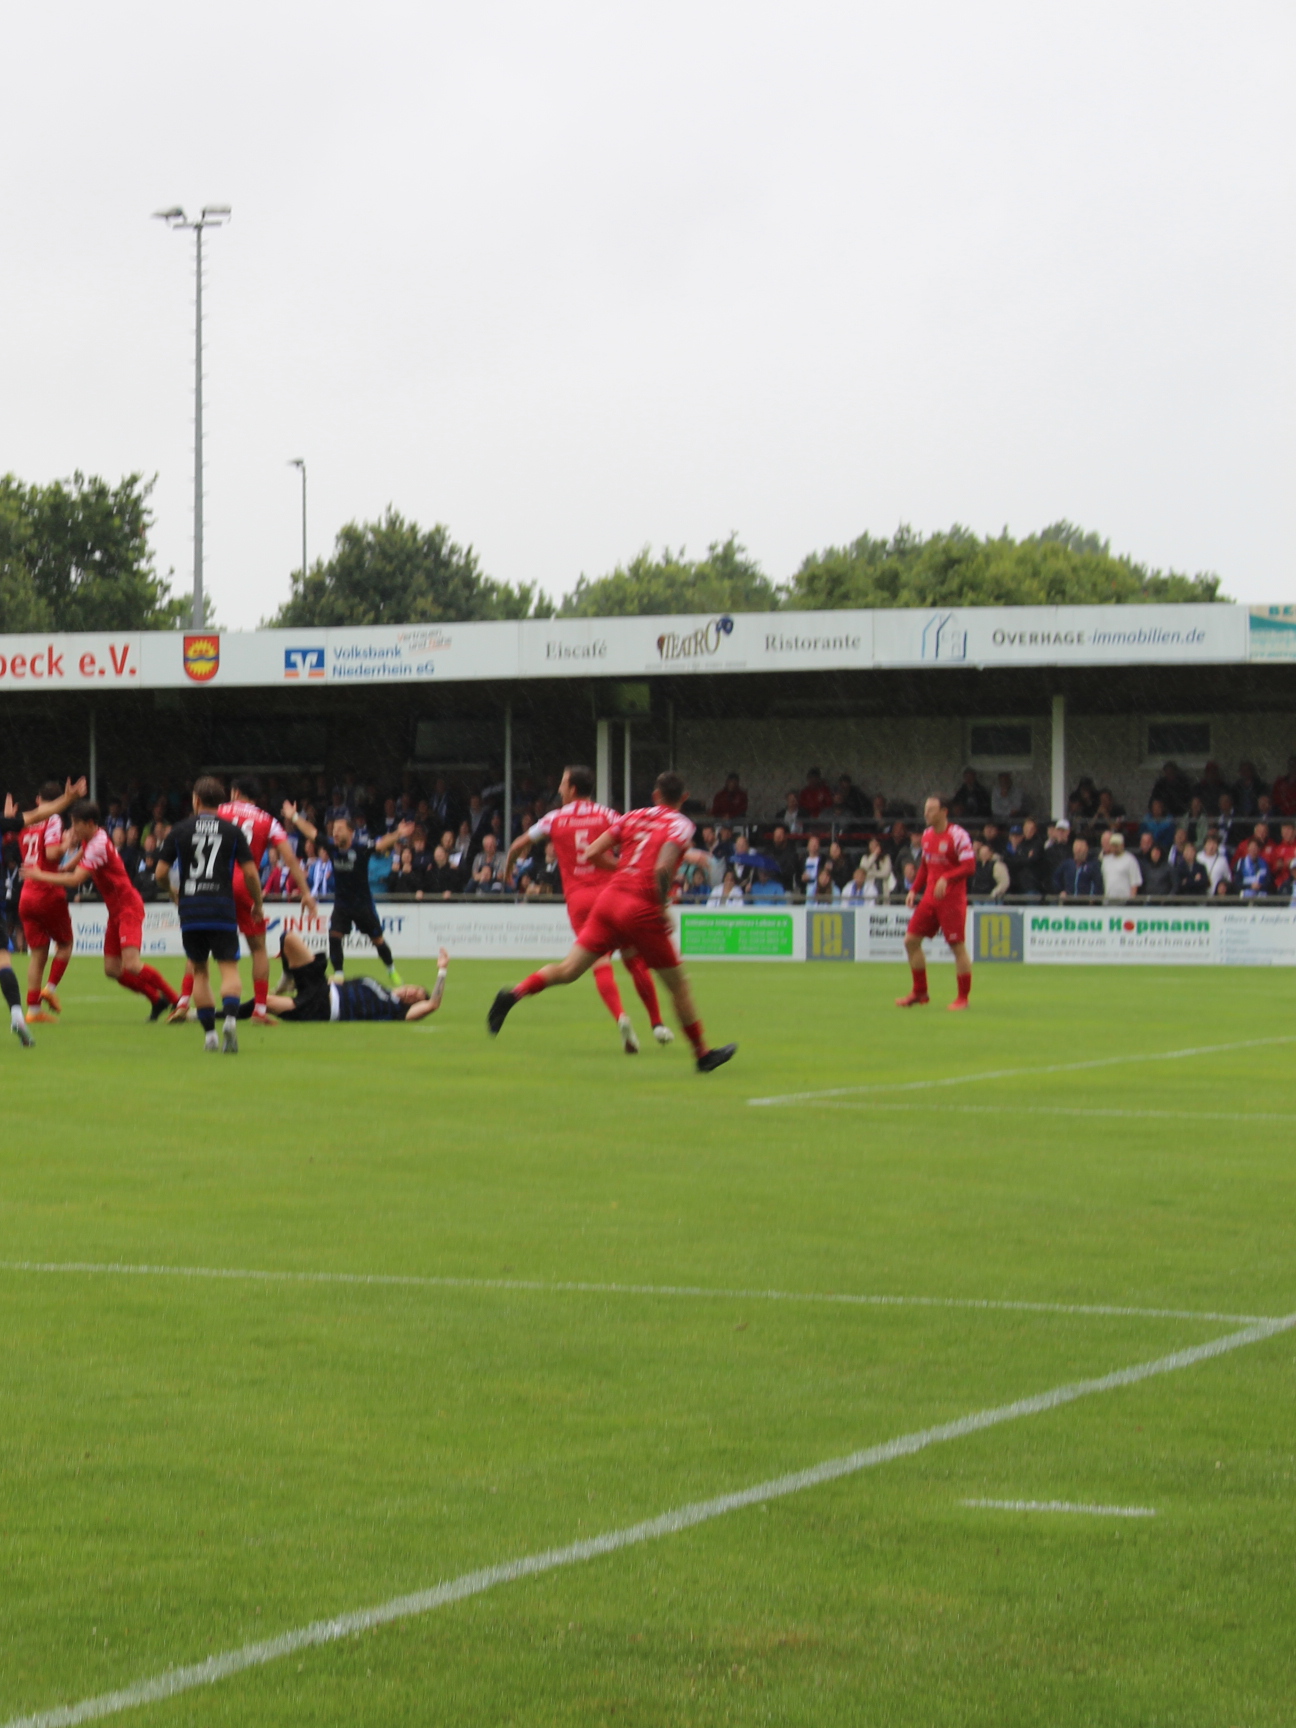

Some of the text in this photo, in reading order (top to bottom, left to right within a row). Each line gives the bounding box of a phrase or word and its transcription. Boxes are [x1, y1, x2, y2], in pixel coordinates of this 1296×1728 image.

[765, 633, 861, 652] Ristorante
[78, 643, 137, 679] e.V.
[333, 645, 402, 661] Volksbank
[332, 660, 435, 678] Niederrhein eG
[574, 828, 591, 865] 5
[628, 831, 653, 867] 7
[189, 833, 223, 880] 37
[1030, 916, 1103, 932] Mobau
[1119, 936, 1210, 947] Baufachmarkt
